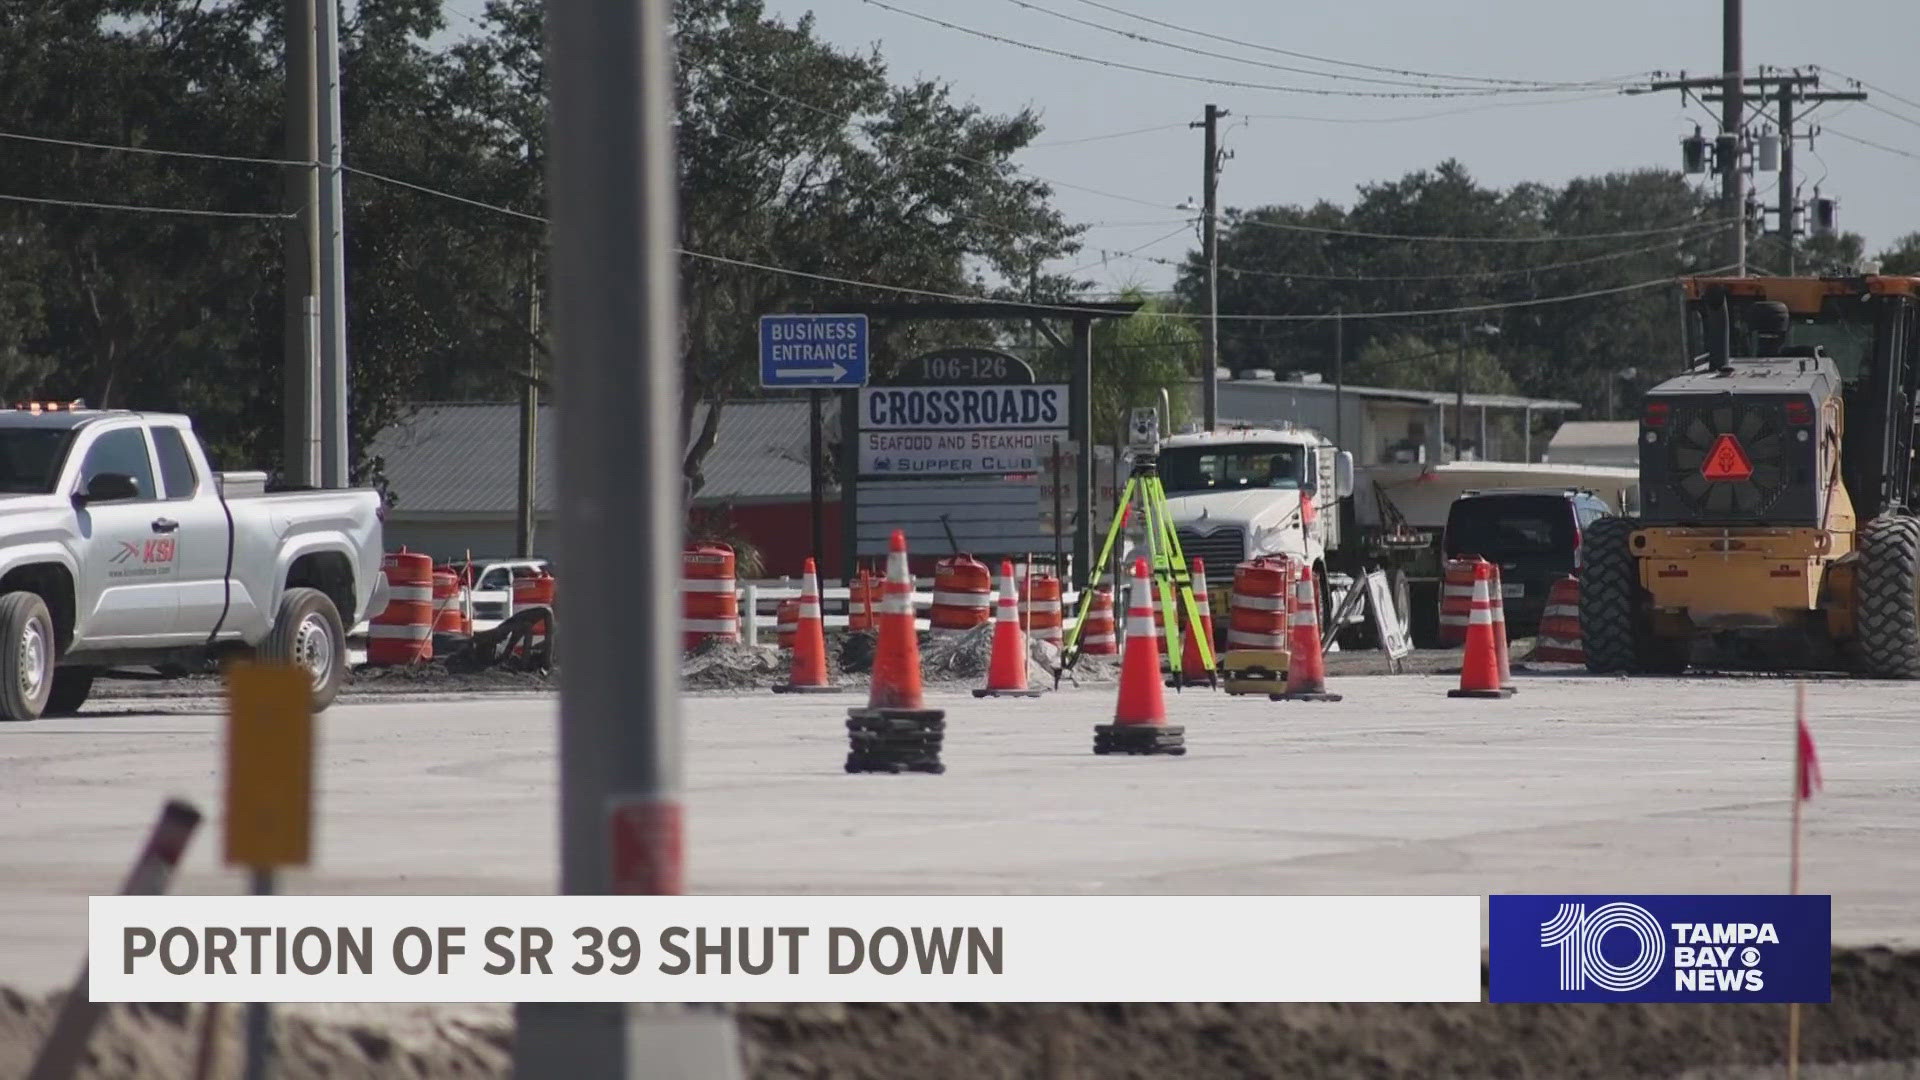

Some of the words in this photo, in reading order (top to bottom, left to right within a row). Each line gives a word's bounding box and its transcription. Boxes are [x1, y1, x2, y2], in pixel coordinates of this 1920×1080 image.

[772, 322, 857, 341] BUSINESS
[772, 343, 858, 360] ENTRANCE
[922, 356, 1008, 379] 106-126
[869, 389, 1058, 425] CROSSROADS
[938, 435, 966, 449] AND
[897, 458, 972, 471] SUPPER
[143, 538, 176, 563] KSI
